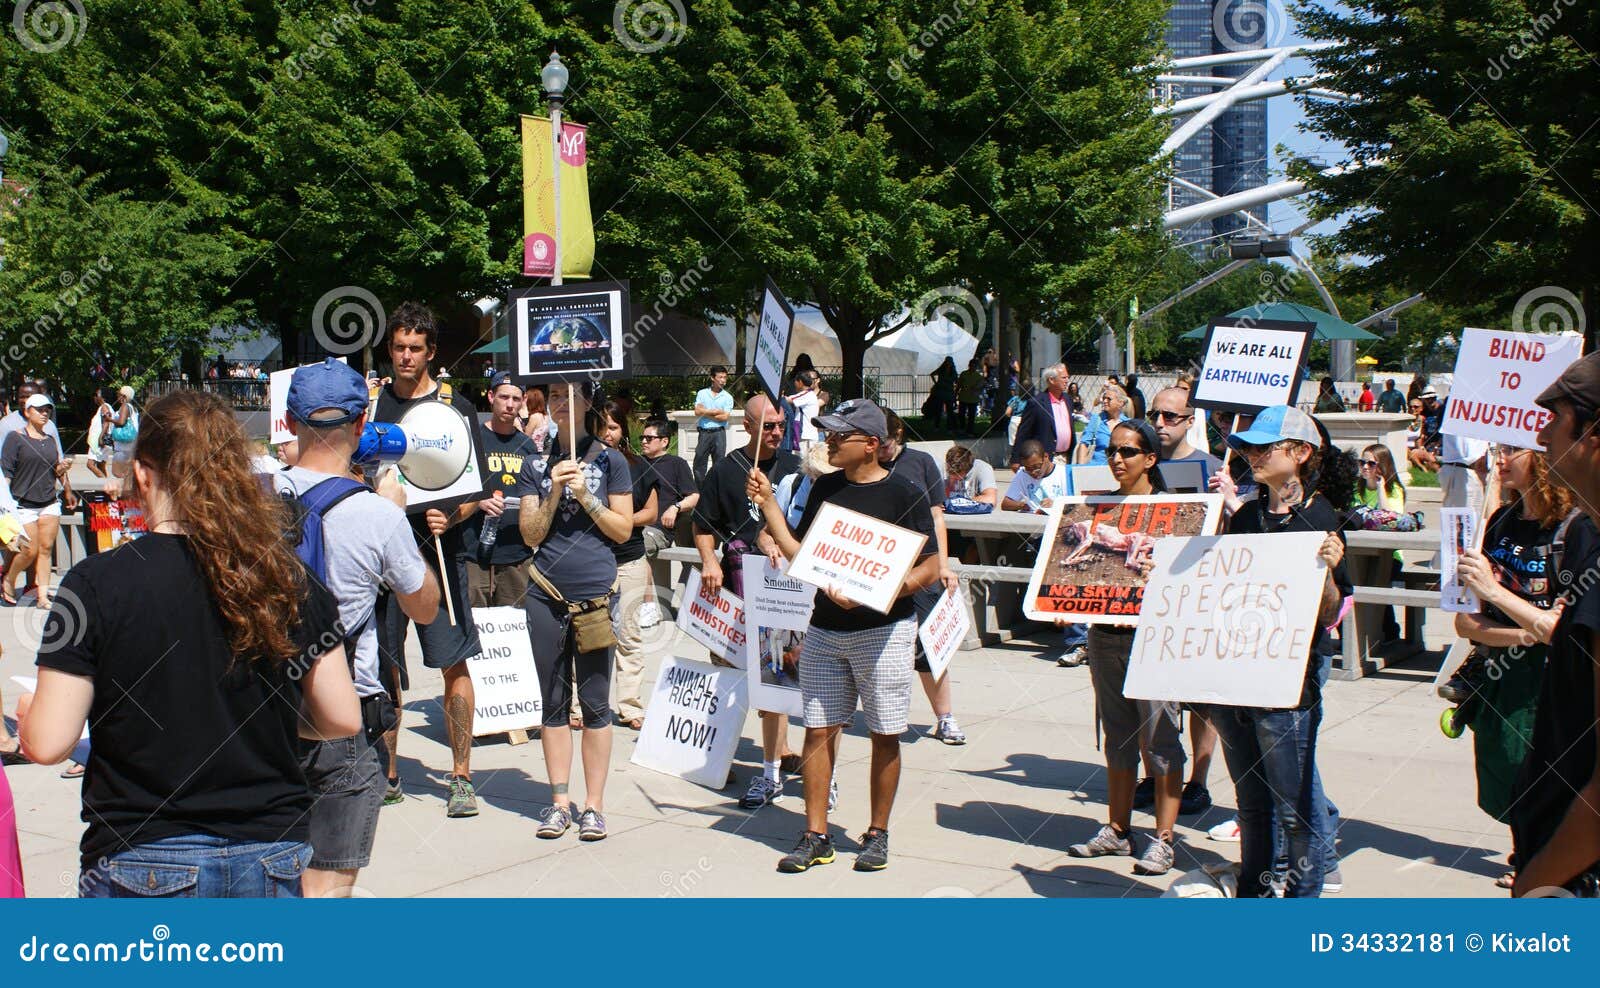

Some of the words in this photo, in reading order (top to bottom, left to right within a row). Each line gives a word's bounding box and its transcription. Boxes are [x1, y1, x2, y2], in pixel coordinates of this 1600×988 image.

[1216, 342, 1237, 354] WE
[1240, 343, 1266, 357] ARE
[1268, 346, 1292, 360] ALL
[1488, 338, 1546, 362] BLIND
[1204, 368, 1290, 387] EARTHLINGS
[1500, 371, 1522, 390] TO
[1090, 502, 1178, 535] FUR
[831, 519, 874, 546] BLIND
[877, 535, 897, 554] TO
[812, 540, 890, 580] INJUSTICE?
[1196, 547, 1254, 578] END
[764, 575, 803, 590] Smoothie
[1048, 584, 1078, 597] NO
[1082, 585, 1131, 599] SKIN
[1052, 600, 1103, 612] YOUR
[1156, 582, 1288, 618] SPECIES
[498, 622, 527, 633] LONG
[1140, 625, 1306, 664] PREJUDICE
[482, 676, 496, 686] TO
[498, 673, 519, 684] THE
[667, 666, 712, 694] ANIMAL
[475, 700, 542, 719] VIOLENCE
[668, 686, 719, 715] RIGHTS
[665, 714, 717, 752] NOW!
